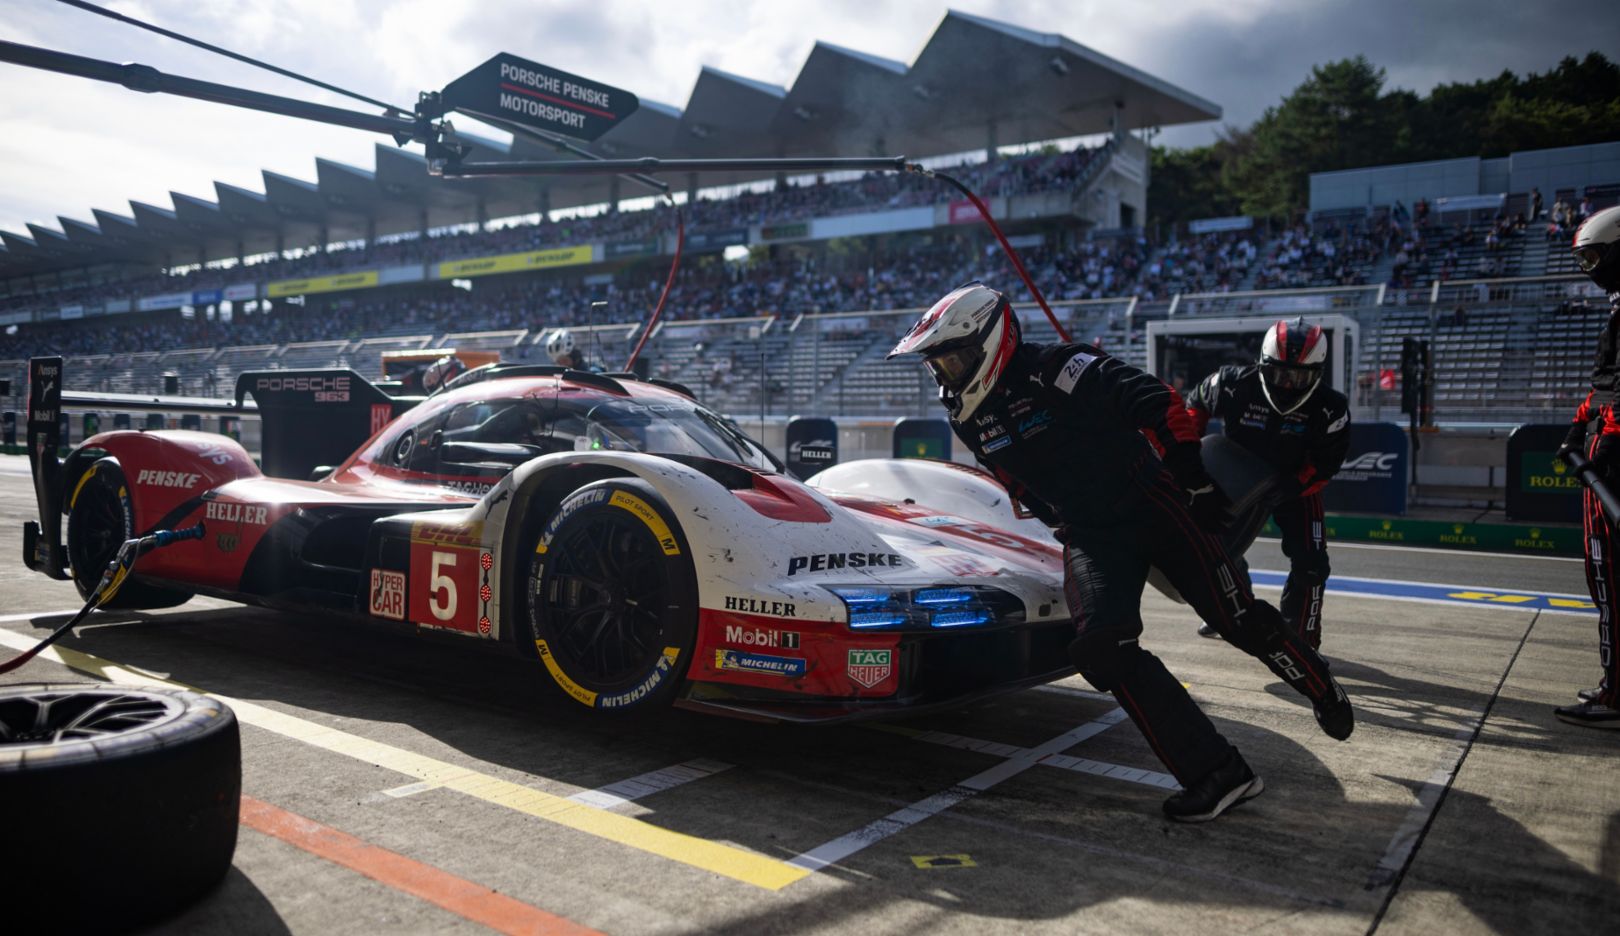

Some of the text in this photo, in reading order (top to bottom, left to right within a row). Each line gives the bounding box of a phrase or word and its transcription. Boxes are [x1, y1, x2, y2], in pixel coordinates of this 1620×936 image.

[501, 62, 609, 108] PORSCHE PENSKE
[500, 93, 586, 129] MOTORSPORT
[257, 377, 350, 391] PORSCHE
[314, 391, 350, 402] 963
[802, 450, 832, 459] HELLER
[136, 469, 202, 489] PENSKE
[1530, 476, 1583, 488] ROLE
[206, 502, 268, 525] HELLER
[550, 488, 607, 530] MICHELIN
[616, 495, 656, 521] PILOT SPORT
[662, 538, 676, 550] M
[1369, 529, 1404, 540] ROLEX
[1440, 533, 1477, 545] ROLEX
[1515, 538, 1554, 549] ROLEX
[787, 552, 904, 576] PENSKE
[373, 572, 403, 591] HYPER
[429, 551, 458, 621] 5
[372, 588, 403, 615] CAR
[725, 596, 796, 617] HELLER
[726, 625, 779, 648] Mobil
[741, 657, 799, 672] MICHELIN
[852, 652, 888, 664] TAG
[850, 667, 889, 684] HEUER
[602, 670, 661, 708] MICHELIN
